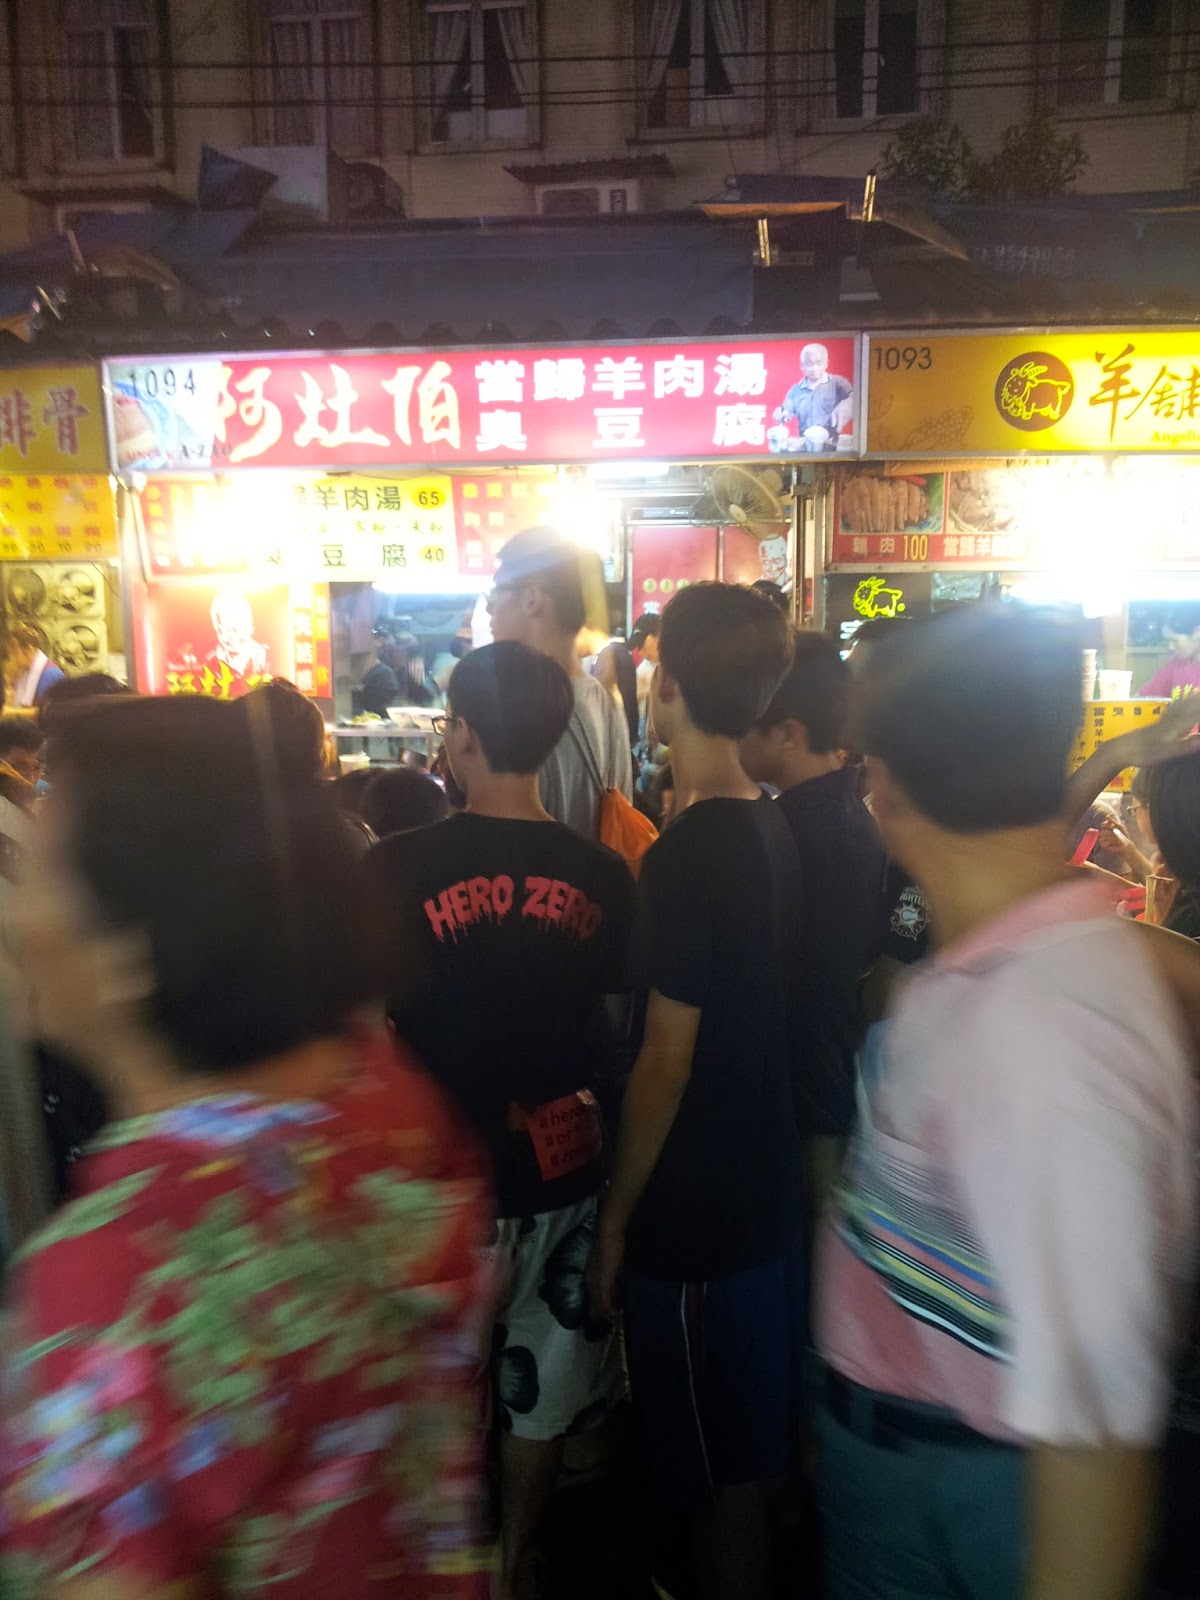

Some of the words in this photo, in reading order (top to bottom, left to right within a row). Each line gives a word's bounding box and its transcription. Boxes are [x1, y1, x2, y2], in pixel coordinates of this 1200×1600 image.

[874, 346, 933, 371] 1093
[129, 368, 197, 397] 1094
[474, 352, 768, 403] 當歸羊肉湯
[213, 361, 461, 463] 阿灶伯
[475, 402, 767, 452] 臭豆腐
[294, 486, 401, 511] 羊肉湯
[418, 491, 440, 505] 65
[424, 548, 445, 562] 40
[904, 535, 928, 561] 100
[943, 535, 1008, 557] 當歸羊
[424, 874, 515, 944] HERO
[521, 876, 604, 942] ZERO
